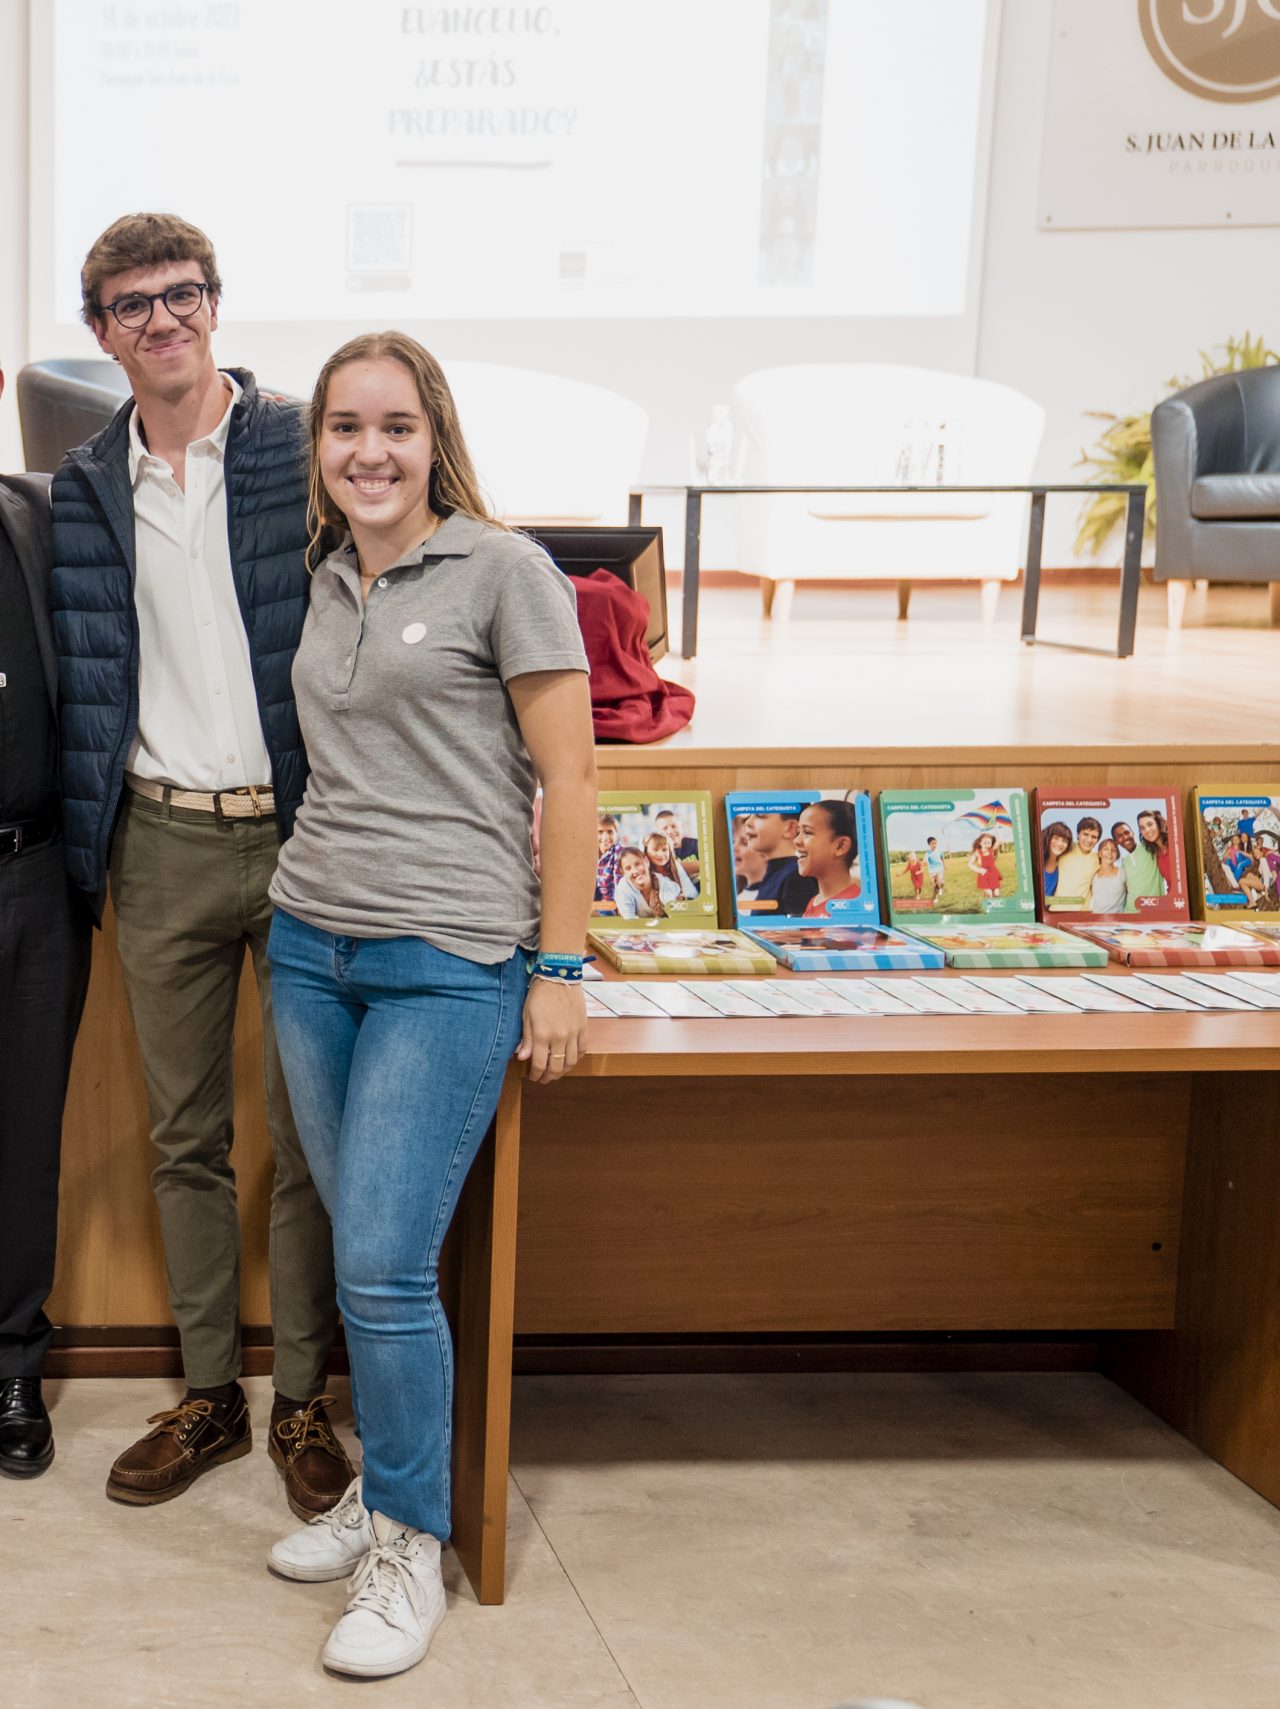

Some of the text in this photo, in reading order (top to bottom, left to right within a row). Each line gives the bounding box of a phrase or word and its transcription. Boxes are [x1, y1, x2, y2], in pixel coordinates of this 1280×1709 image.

[400, 6, 561, 39] EVANGELIO,
[414, 50, 517, 88] ¿ESTÁS
[387, 107, 579, 139] PREPARADO?
[1146, 132, 1206, 155] JUAN
[1212, 131, 1242, 151] DE
[1248, 130, 1276, 150] LA
